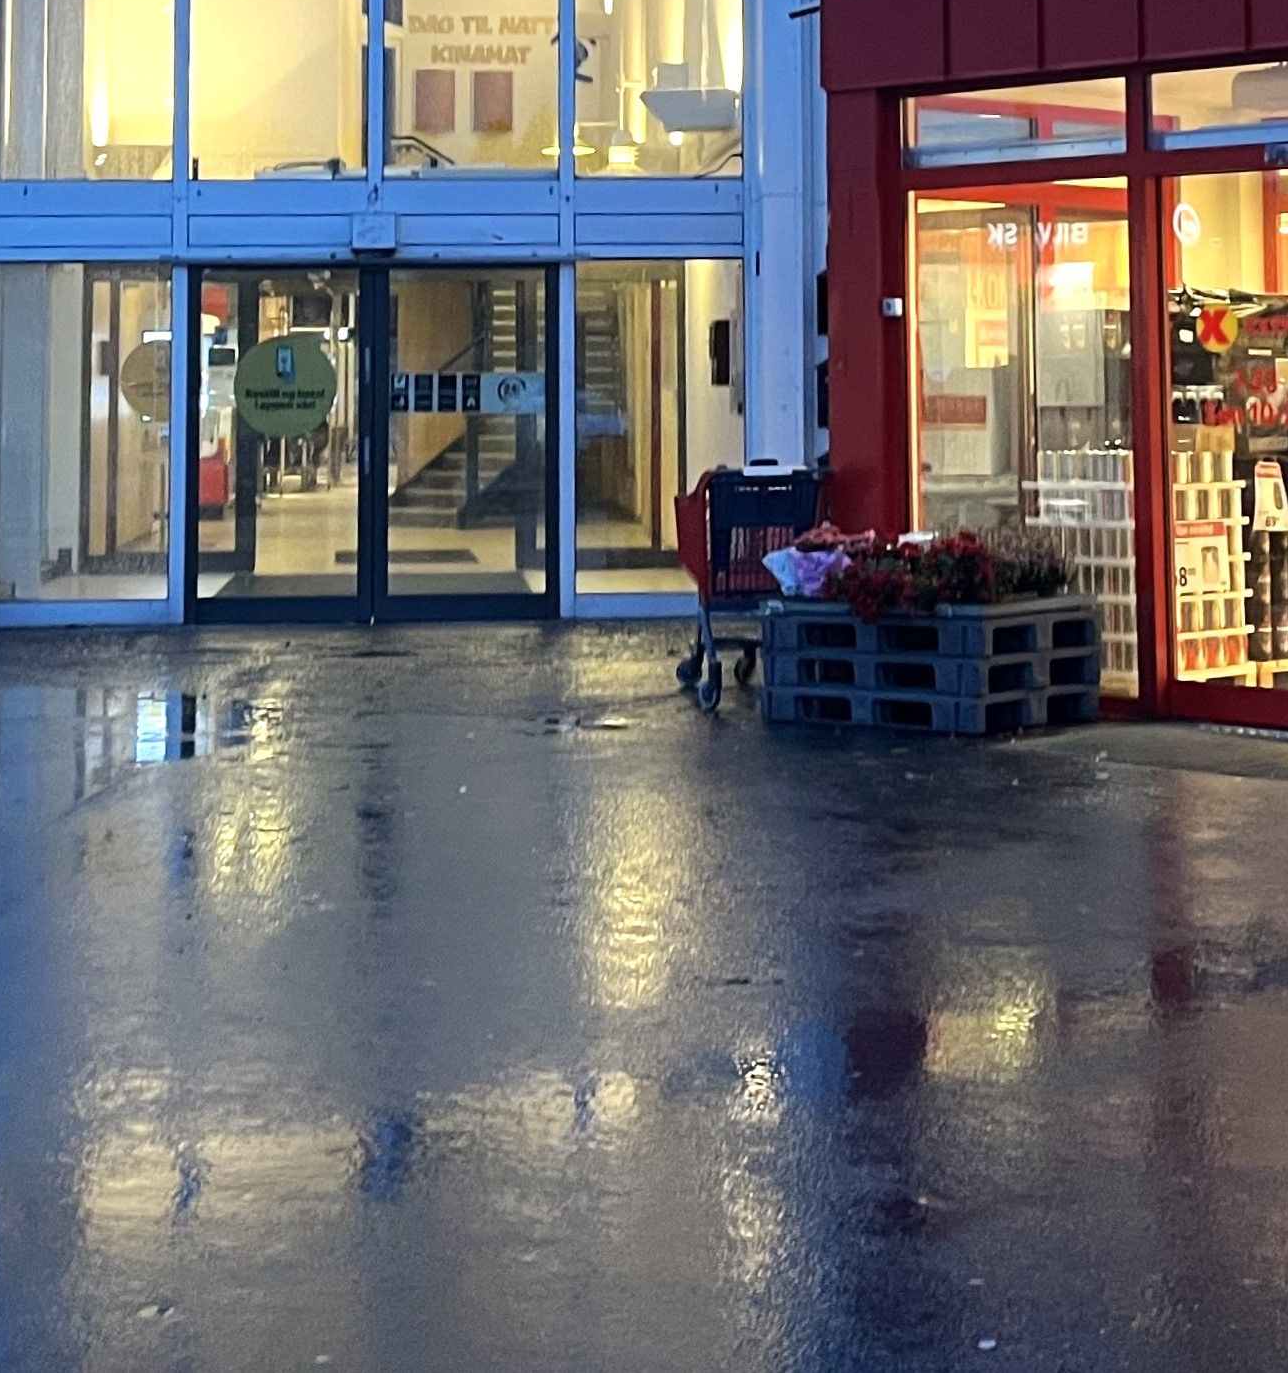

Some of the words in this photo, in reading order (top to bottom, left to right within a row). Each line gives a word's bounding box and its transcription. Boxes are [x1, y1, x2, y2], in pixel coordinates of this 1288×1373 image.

[408, 14, 455, 35] DAG
[461, 14, 492, 35] TIL
[499, 14, 556, 35] NATT
[430, 44, 531, 65] KINAMAT
